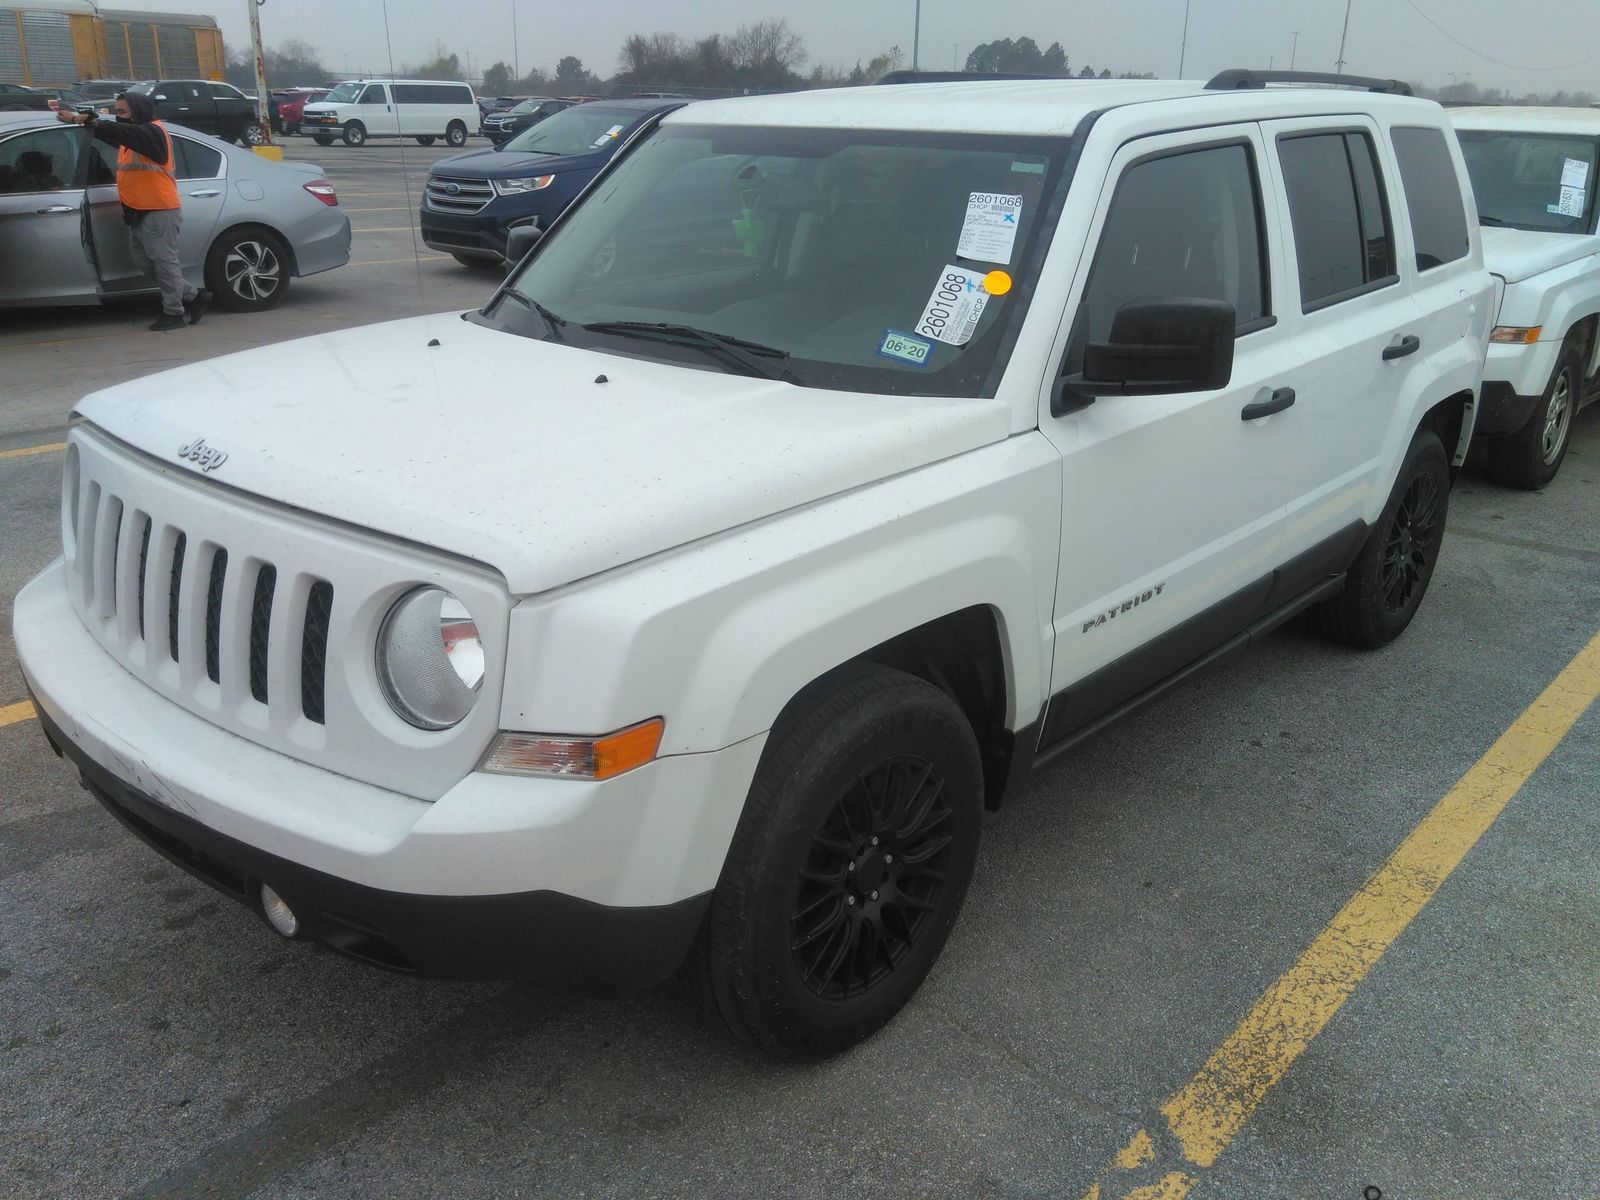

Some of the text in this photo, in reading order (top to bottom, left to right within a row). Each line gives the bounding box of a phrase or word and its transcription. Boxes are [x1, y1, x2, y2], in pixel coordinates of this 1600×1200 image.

[969, 193, 1022, 208] 2601068
[921, 273, 966, 338] 2601068
[968, 298, 984, 322] CHCP
[886, 339, 926, 358] 06 20
[178, 437, 228, 473] Jeep
[1082, 582, 1166, 633] PATRIOT
